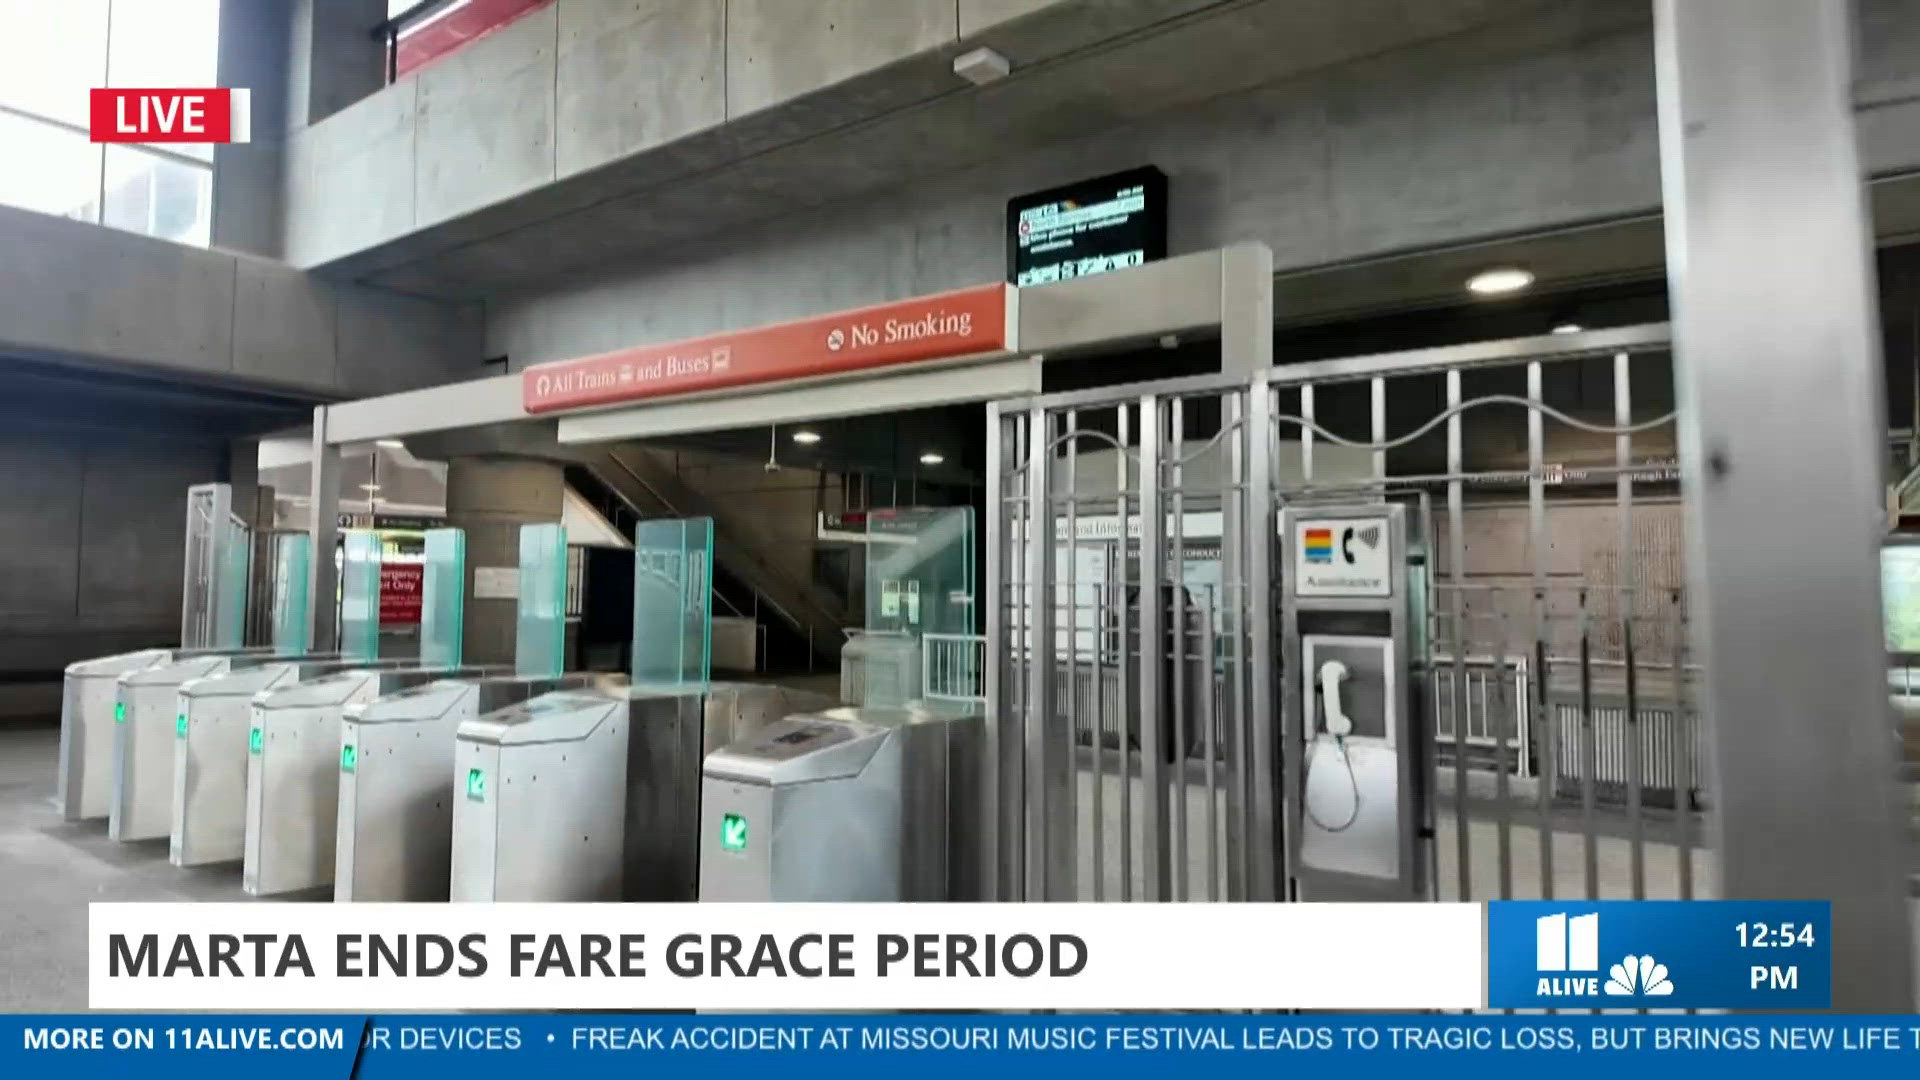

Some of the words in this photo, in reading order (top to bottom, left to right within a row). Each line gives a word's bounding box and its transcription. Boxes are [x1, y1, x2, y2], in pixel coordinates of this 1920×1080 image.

[851, 323, 879, 349] No
[884, 309, 973, 344] Smoking
[552, 376, 573, 394] All
[577, 370, 617, 390] Trains
[637, 359, 662, 379] and
[667, 355, 710, 377] Buses
